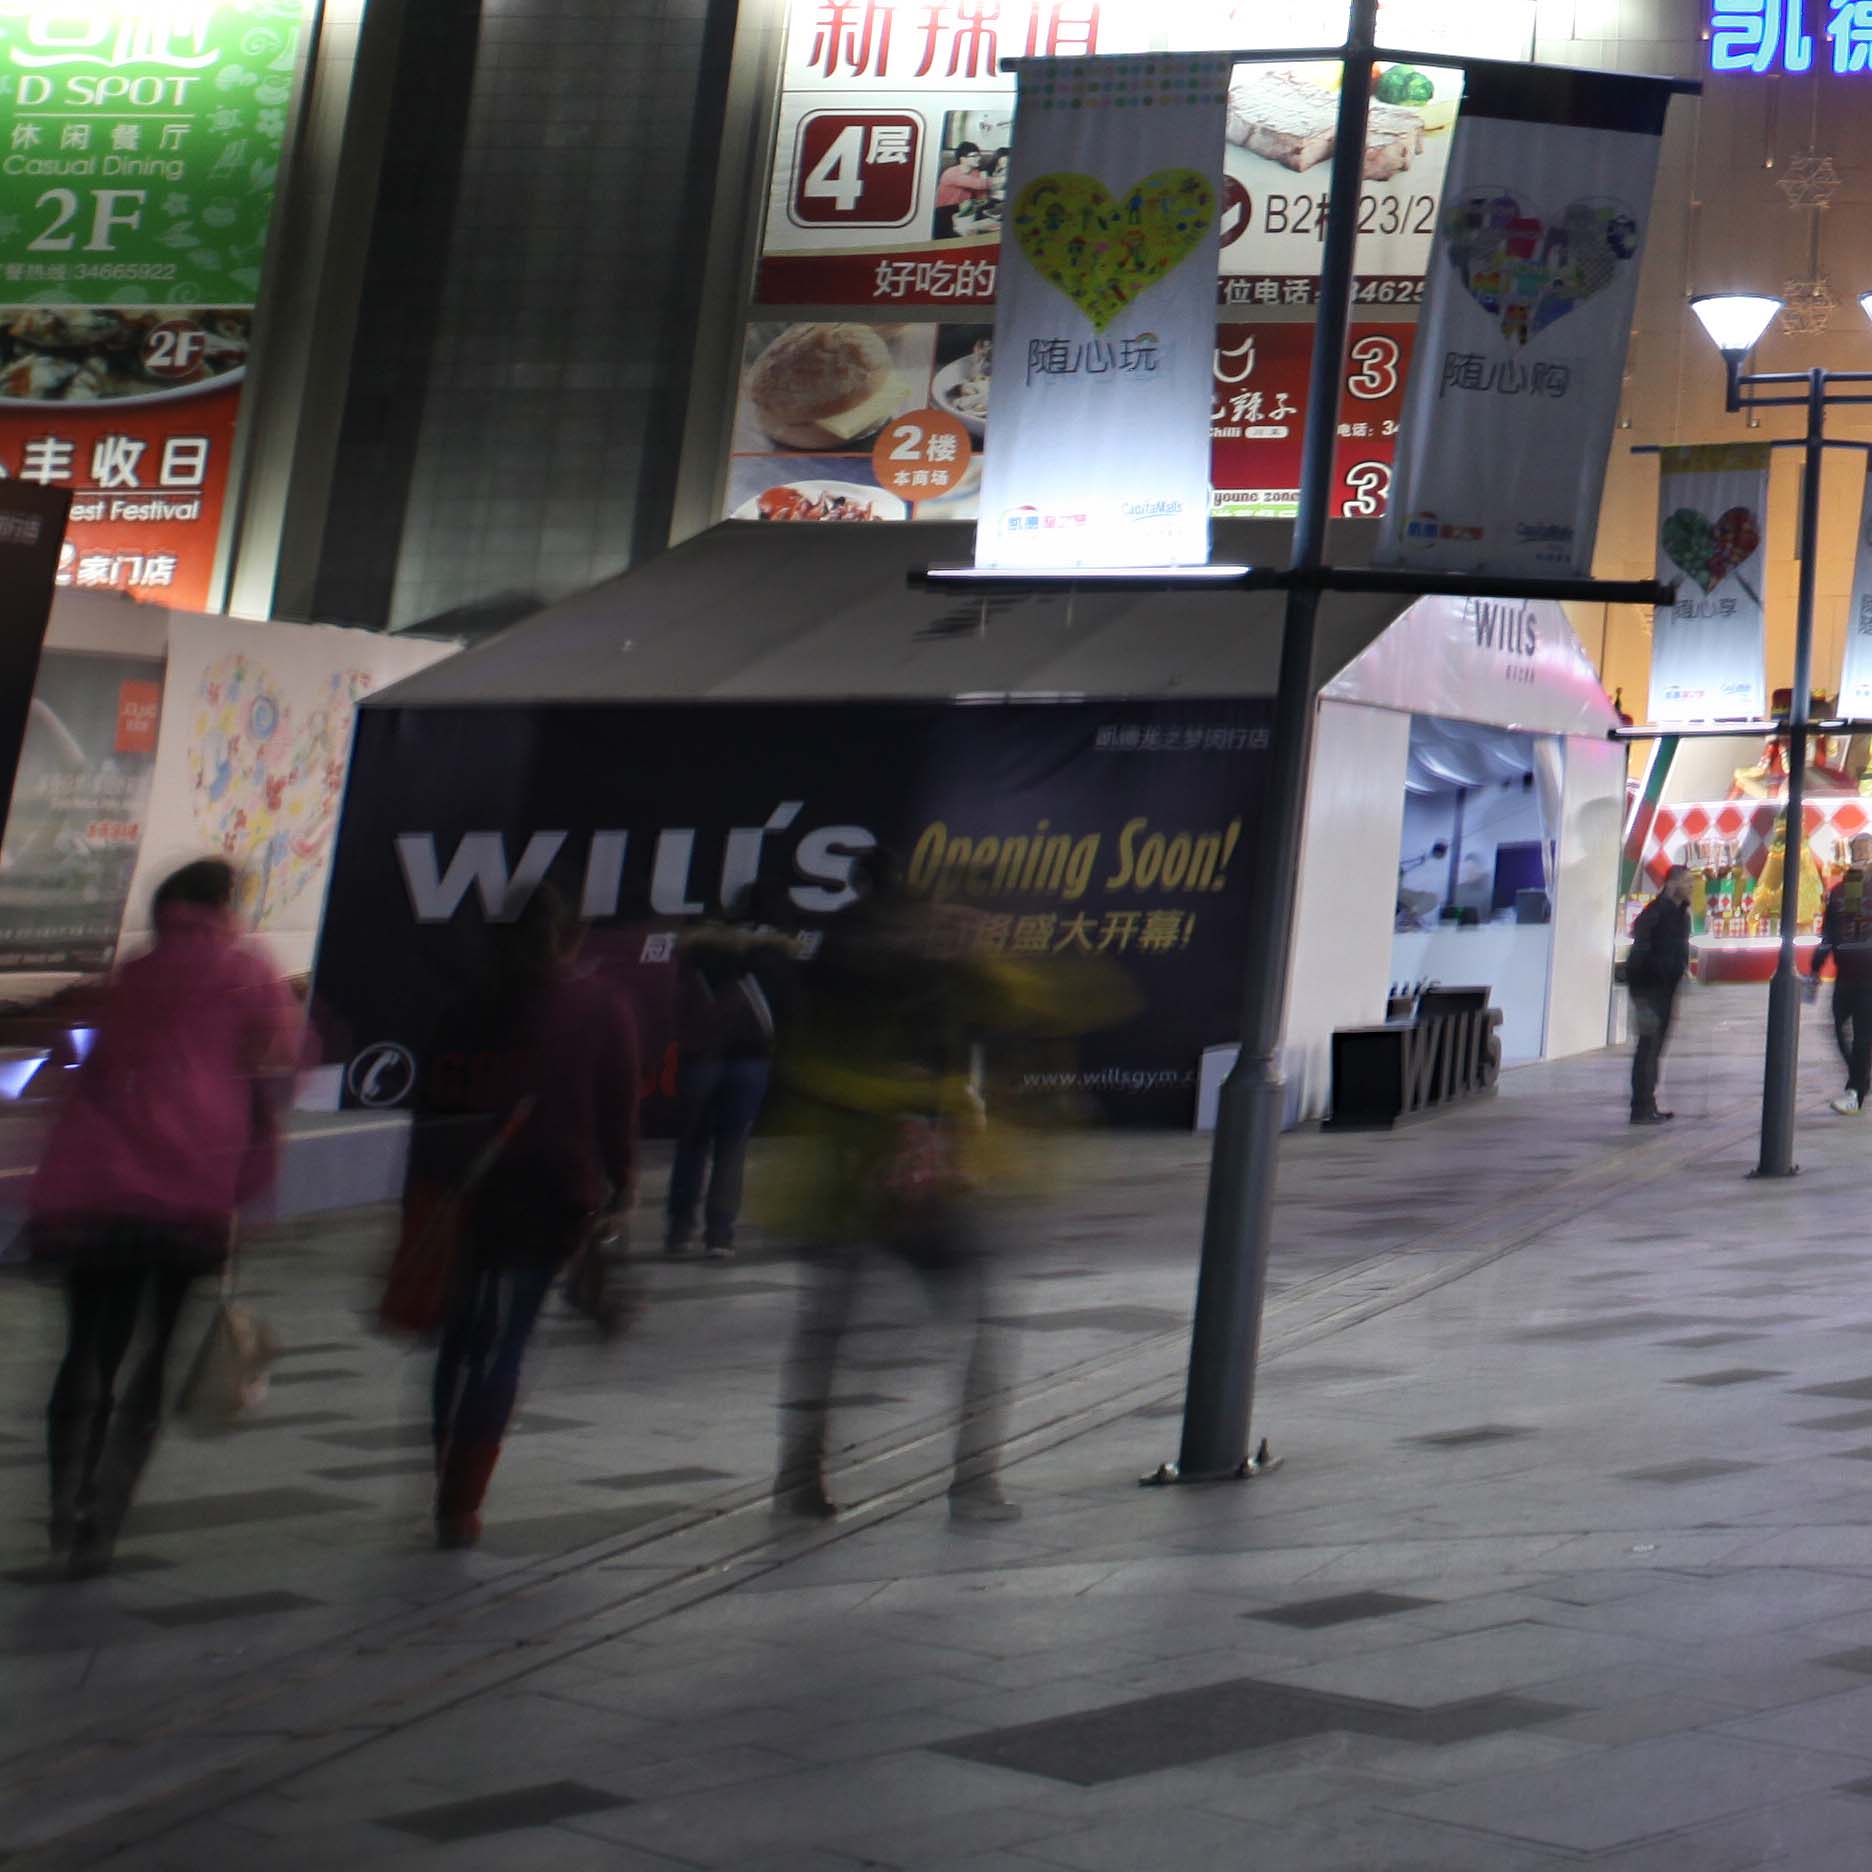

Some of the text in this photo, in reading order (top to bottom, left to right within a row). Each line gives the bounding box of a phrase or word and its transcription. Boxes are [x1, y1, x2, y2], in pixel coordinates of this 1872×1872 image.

[16, 75, 201, 107] D SPOT
[11, 122, 193, 152] 休闲餐厅
[2, 154, 185, 181] Casual Dining
[803, 125, 914, 211] 4层
[27, 187, 147, 252] 2F
[873, 259, 998, 298] 好吃的
[145, 330, 206, 368] 2F
[1026, 336, 1160, 386] 随心玩
[1349, 335, 1400, 400] 3
[1440, 350, 1571, 398] 随心购
[20, 436, 209, 487] 丰收日
[889, 425, 958, 463] 2楼
[893, 469, 950, 487] 本商场
[110, 499, 201, 522] Festival
[909, 816, 1243, 900] Opening Soon!
